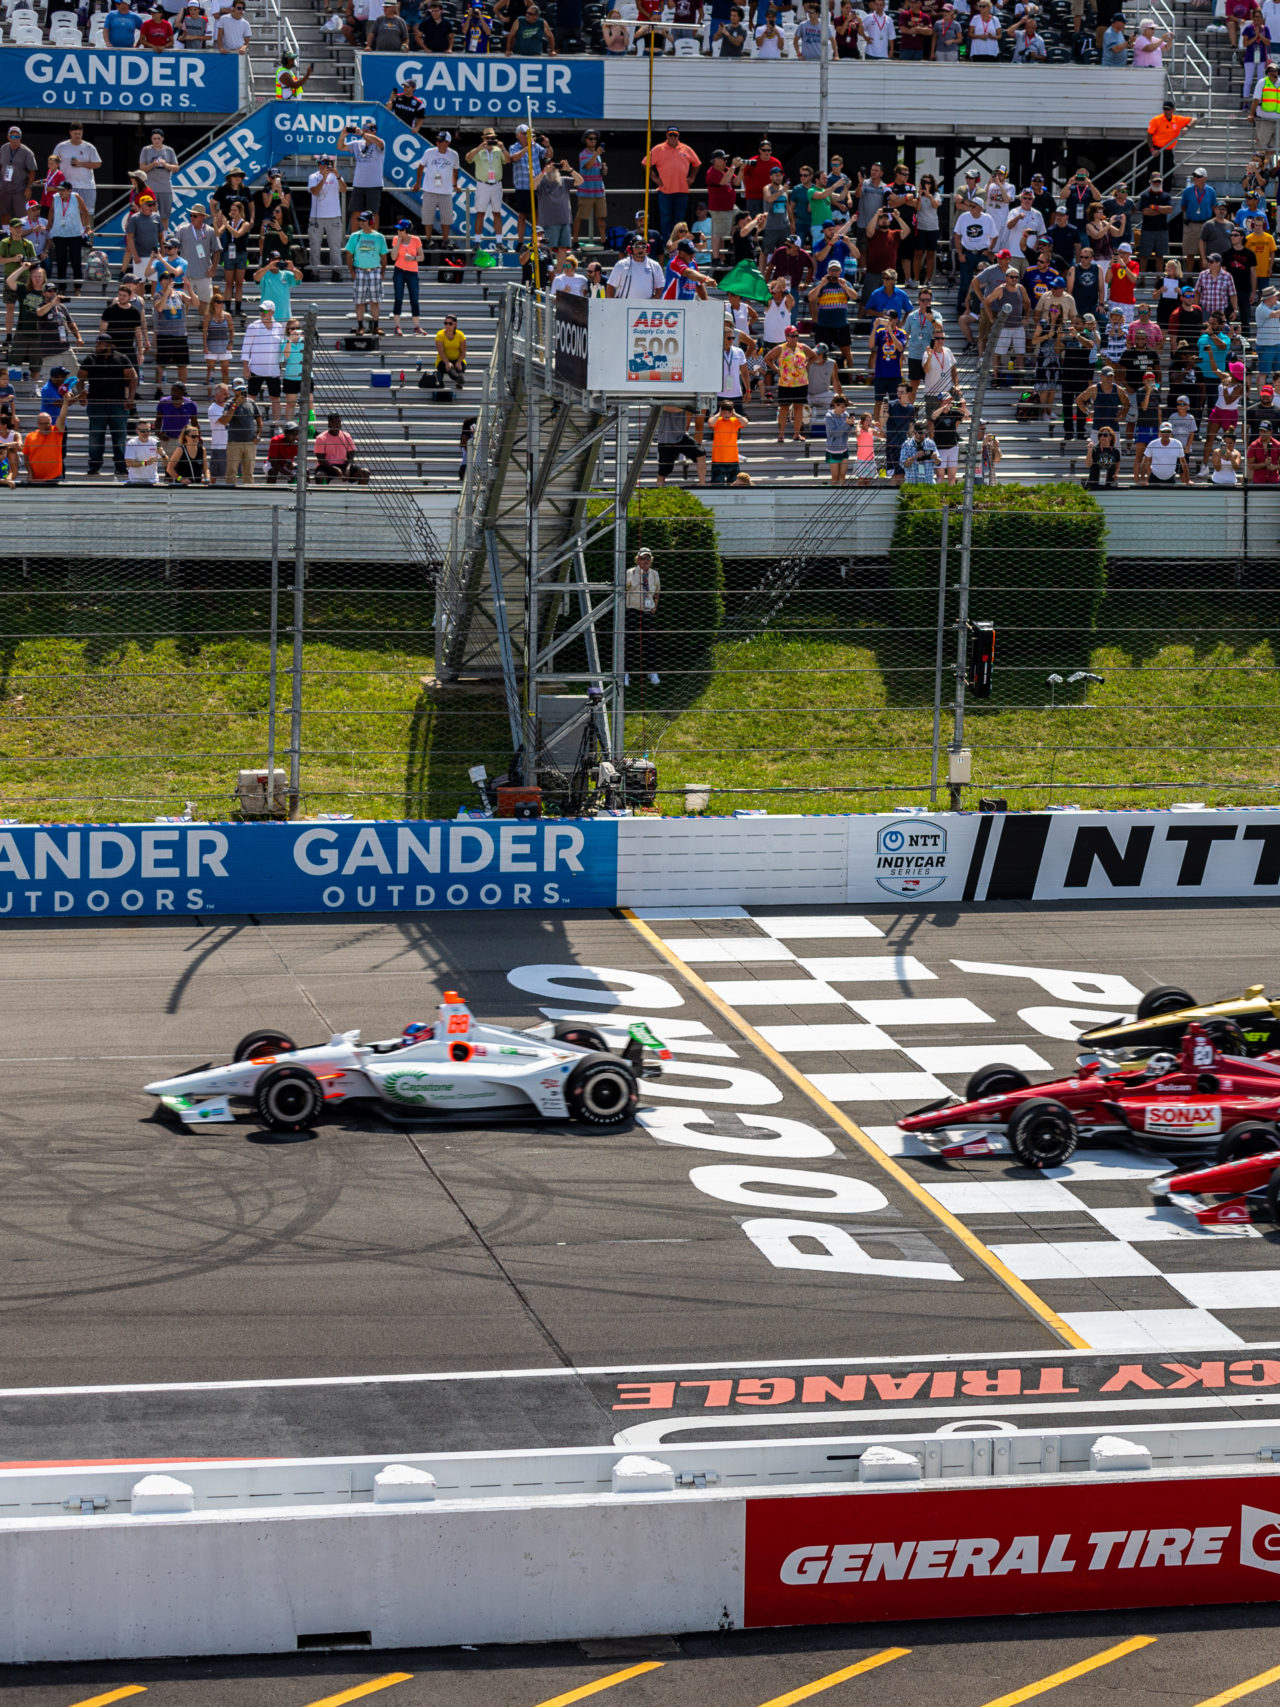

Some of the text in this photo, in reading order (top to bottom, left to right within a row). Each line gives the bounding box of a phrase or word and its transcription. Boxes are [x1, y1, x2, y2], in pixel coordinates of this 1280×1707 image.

[24, 53, 206, 88] GANDER
[395, 60, 572, 95] GANDER
[42, 89, 191, 108] OUTDOORS
[631, 311, 680, 328] ABC
[555, 319, 588, 360] POCONO
[632, 328, 654, 336] Supply
[633, 337, 680, 356] 500
[908, 834, 941, 847] NTT
[0, 829, 230, 880] ANDER
[293, 825, 585, 876] GANDER
[876, 855, 946, 869] INDYCAR
[890, 868, 931, 876] SERIES
[0, 888, 204, 913] UTDOORS
[322, 883, 560, 908] OUTDOORS
[400, 1082, 454, 1093] Capstone
[1155, 1082, 1192, 1093] Belcan
[1149, 1107, 1215, 1123] SONAX
[612, 1367, 1080, 1410] TRIANGLE
[779, 1533, 1077, 1586] GENERAL
[1087, 1525, 1232, 1571] TIRE
